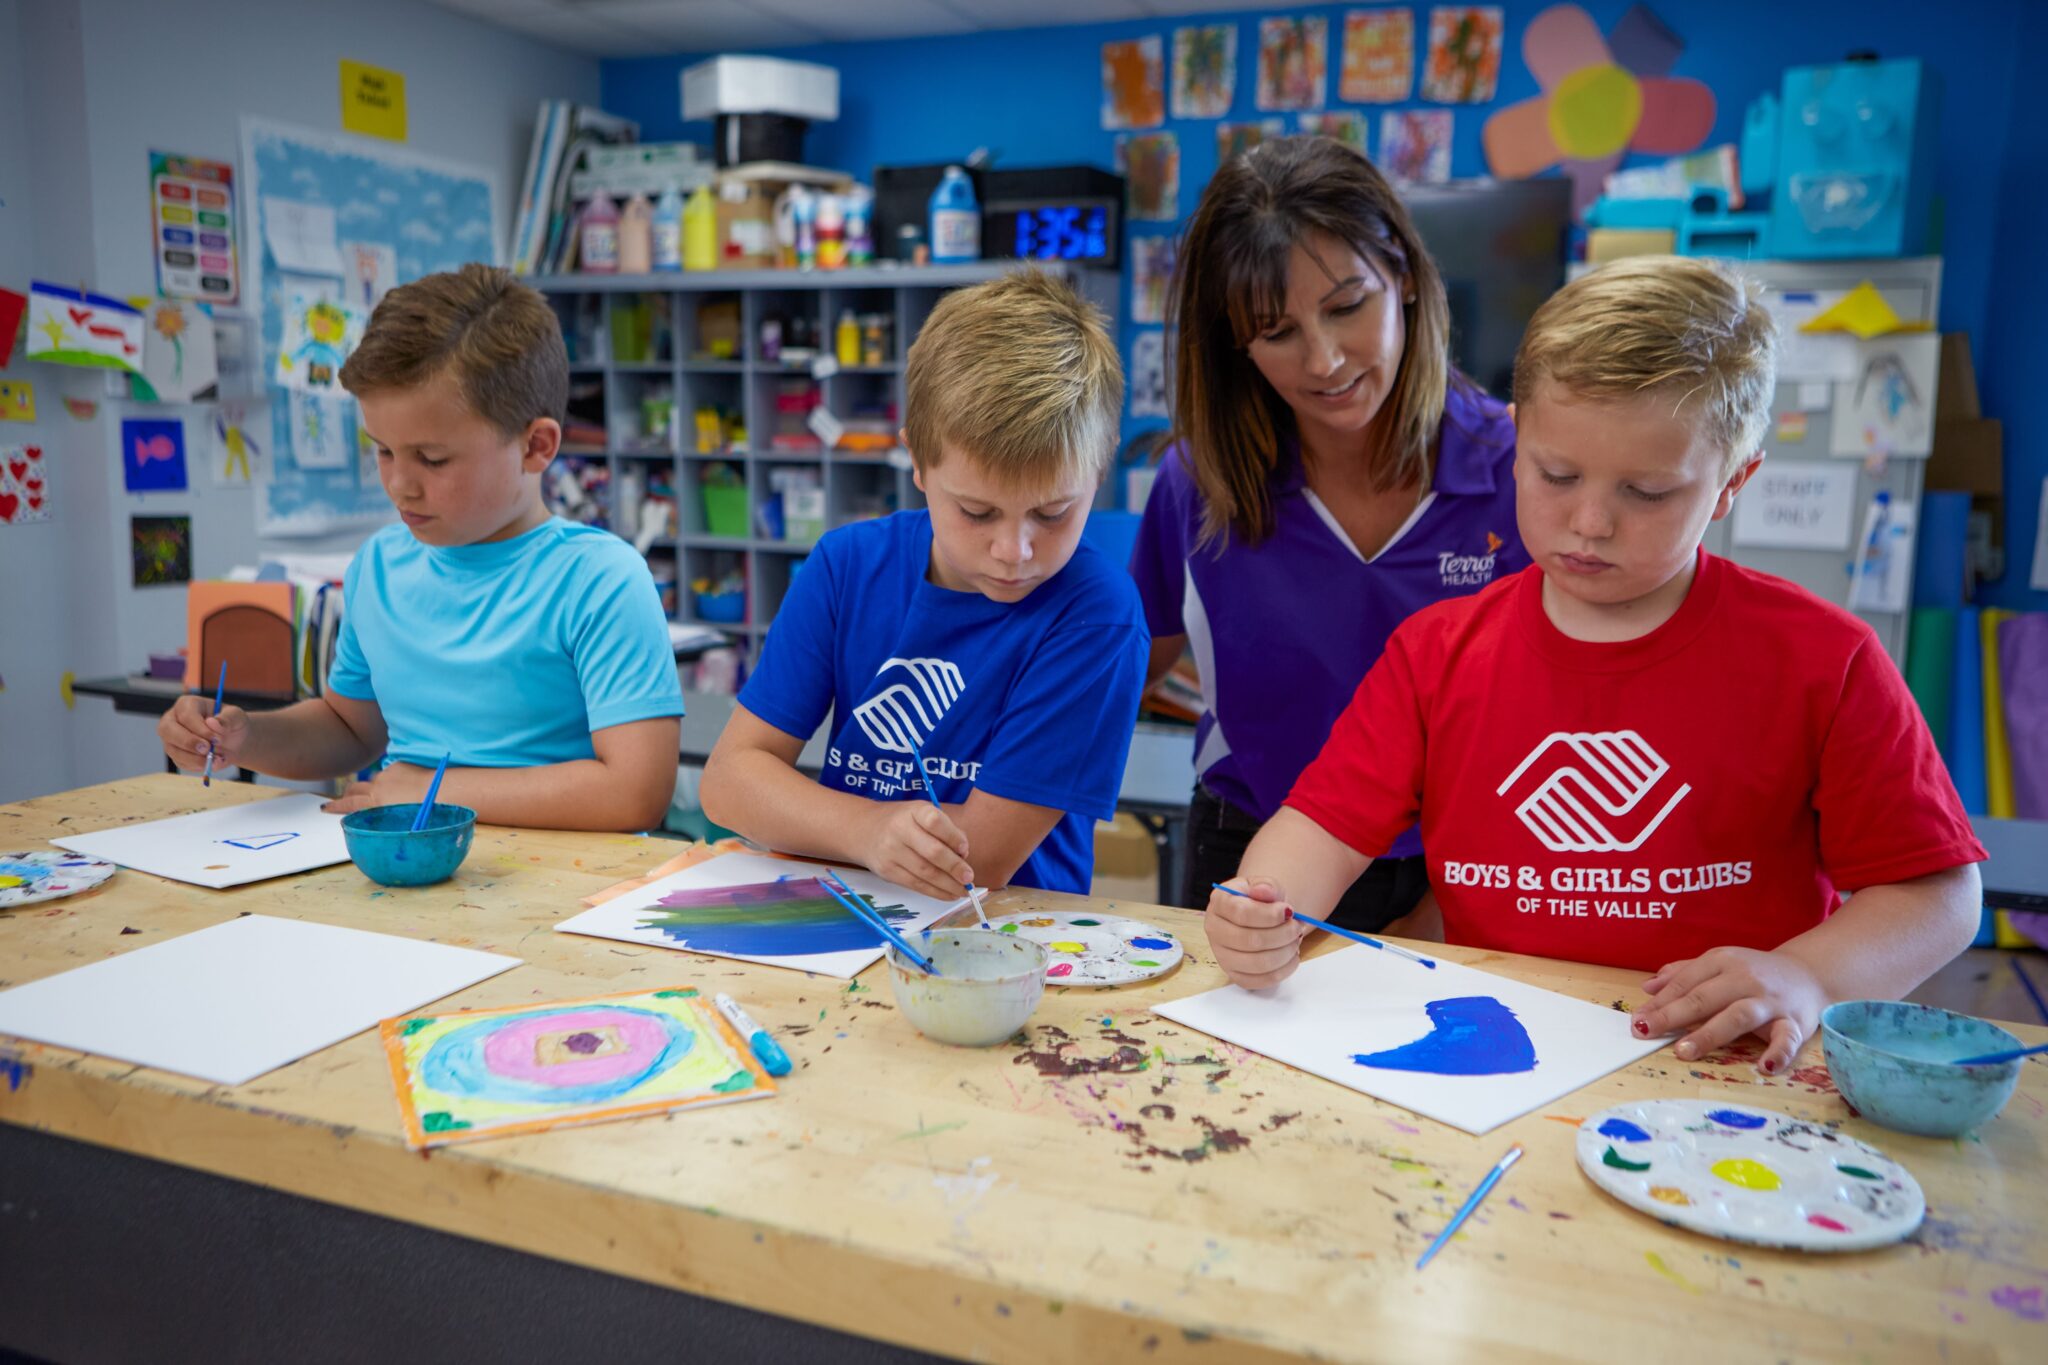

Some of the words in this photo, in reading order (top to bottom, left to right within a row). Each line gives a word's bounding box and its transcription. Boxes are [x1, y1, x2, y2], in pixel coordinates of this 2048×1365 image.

[1438, 552, 1496, 575] Terros
[1442, 572, 1492, 586] HEALTH
[922, 756, 982, 782] CLU
[844, 774, 868, 788] OF
[1444, 860, 1511, 889] BOYS
[1516, 865, 1544, 891] &
[1550, 866, 1651, 893] GIRLS
[1658, 860, 1753, 894] CLUBS
[1516, 896, 1541, 913] OF
[1546, 898, 1588, 917] THE
[1594, 900, 1677, 919] VALLEY
